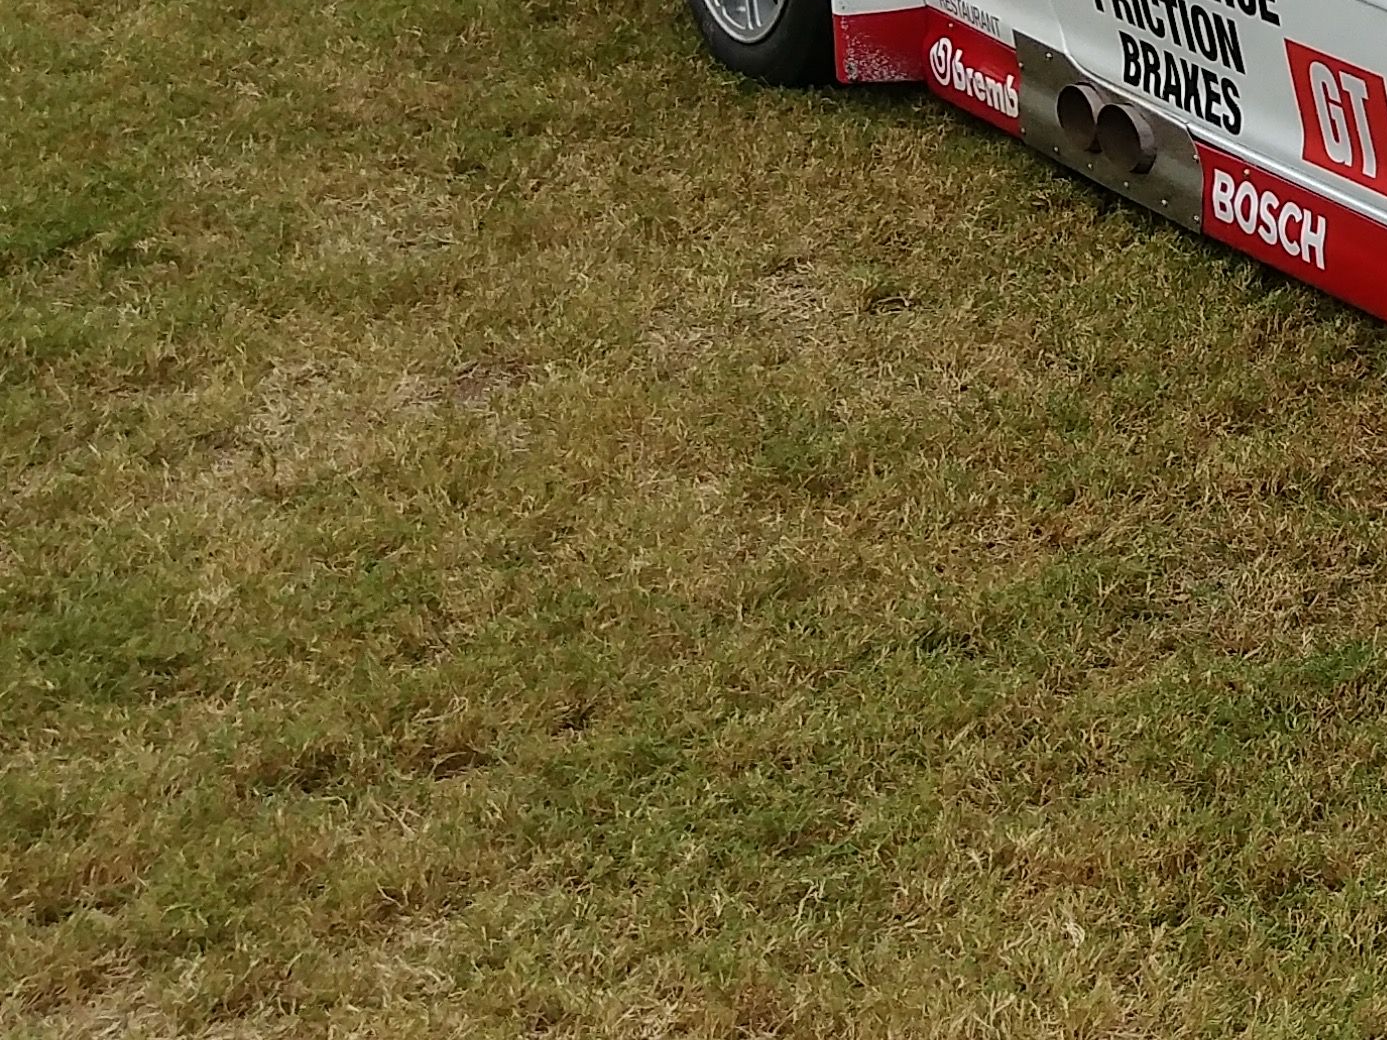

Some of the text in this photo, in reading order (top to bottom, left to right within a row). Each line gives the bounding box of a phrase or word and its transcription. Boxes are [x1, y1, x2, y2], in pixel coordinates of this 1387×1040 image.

[1118, 30, 1242, 136] BRAKES
[1309, 61, 1377, 179] GT
[1212, 168, 1327, 270] BOSCH
